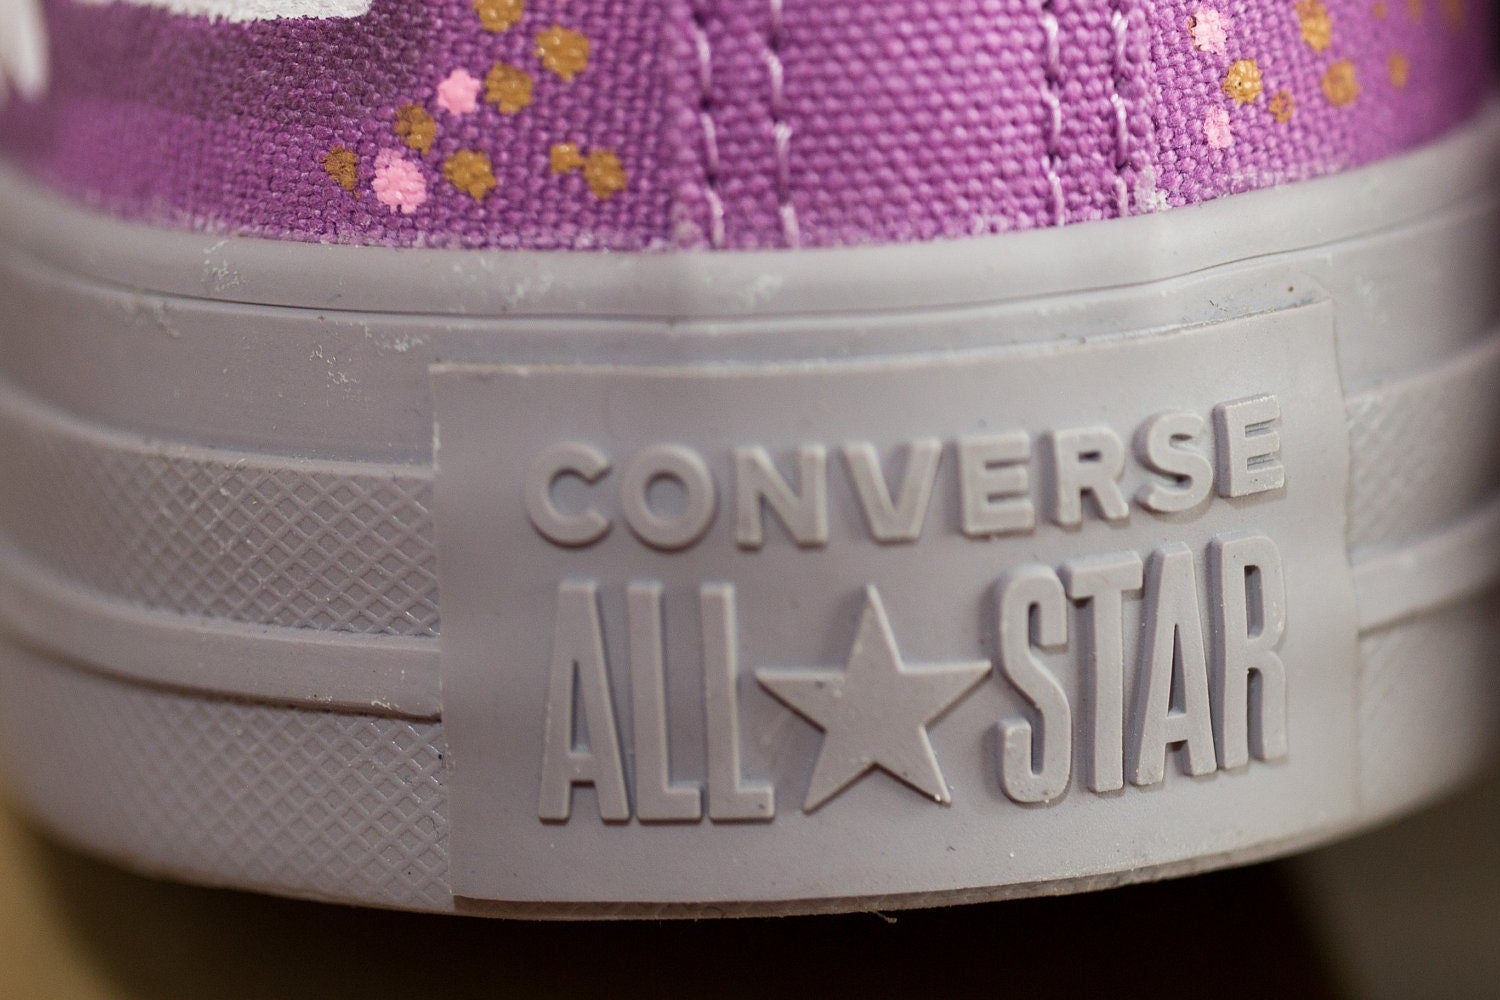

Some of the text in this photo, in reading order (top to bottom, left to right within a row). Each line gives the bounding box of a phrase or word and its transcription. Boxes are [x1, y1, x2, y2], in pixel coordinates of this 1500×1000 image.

[525, 394, 1286, 551] CONVERSE
[537, 533, 1289, 824] ALL STAR
